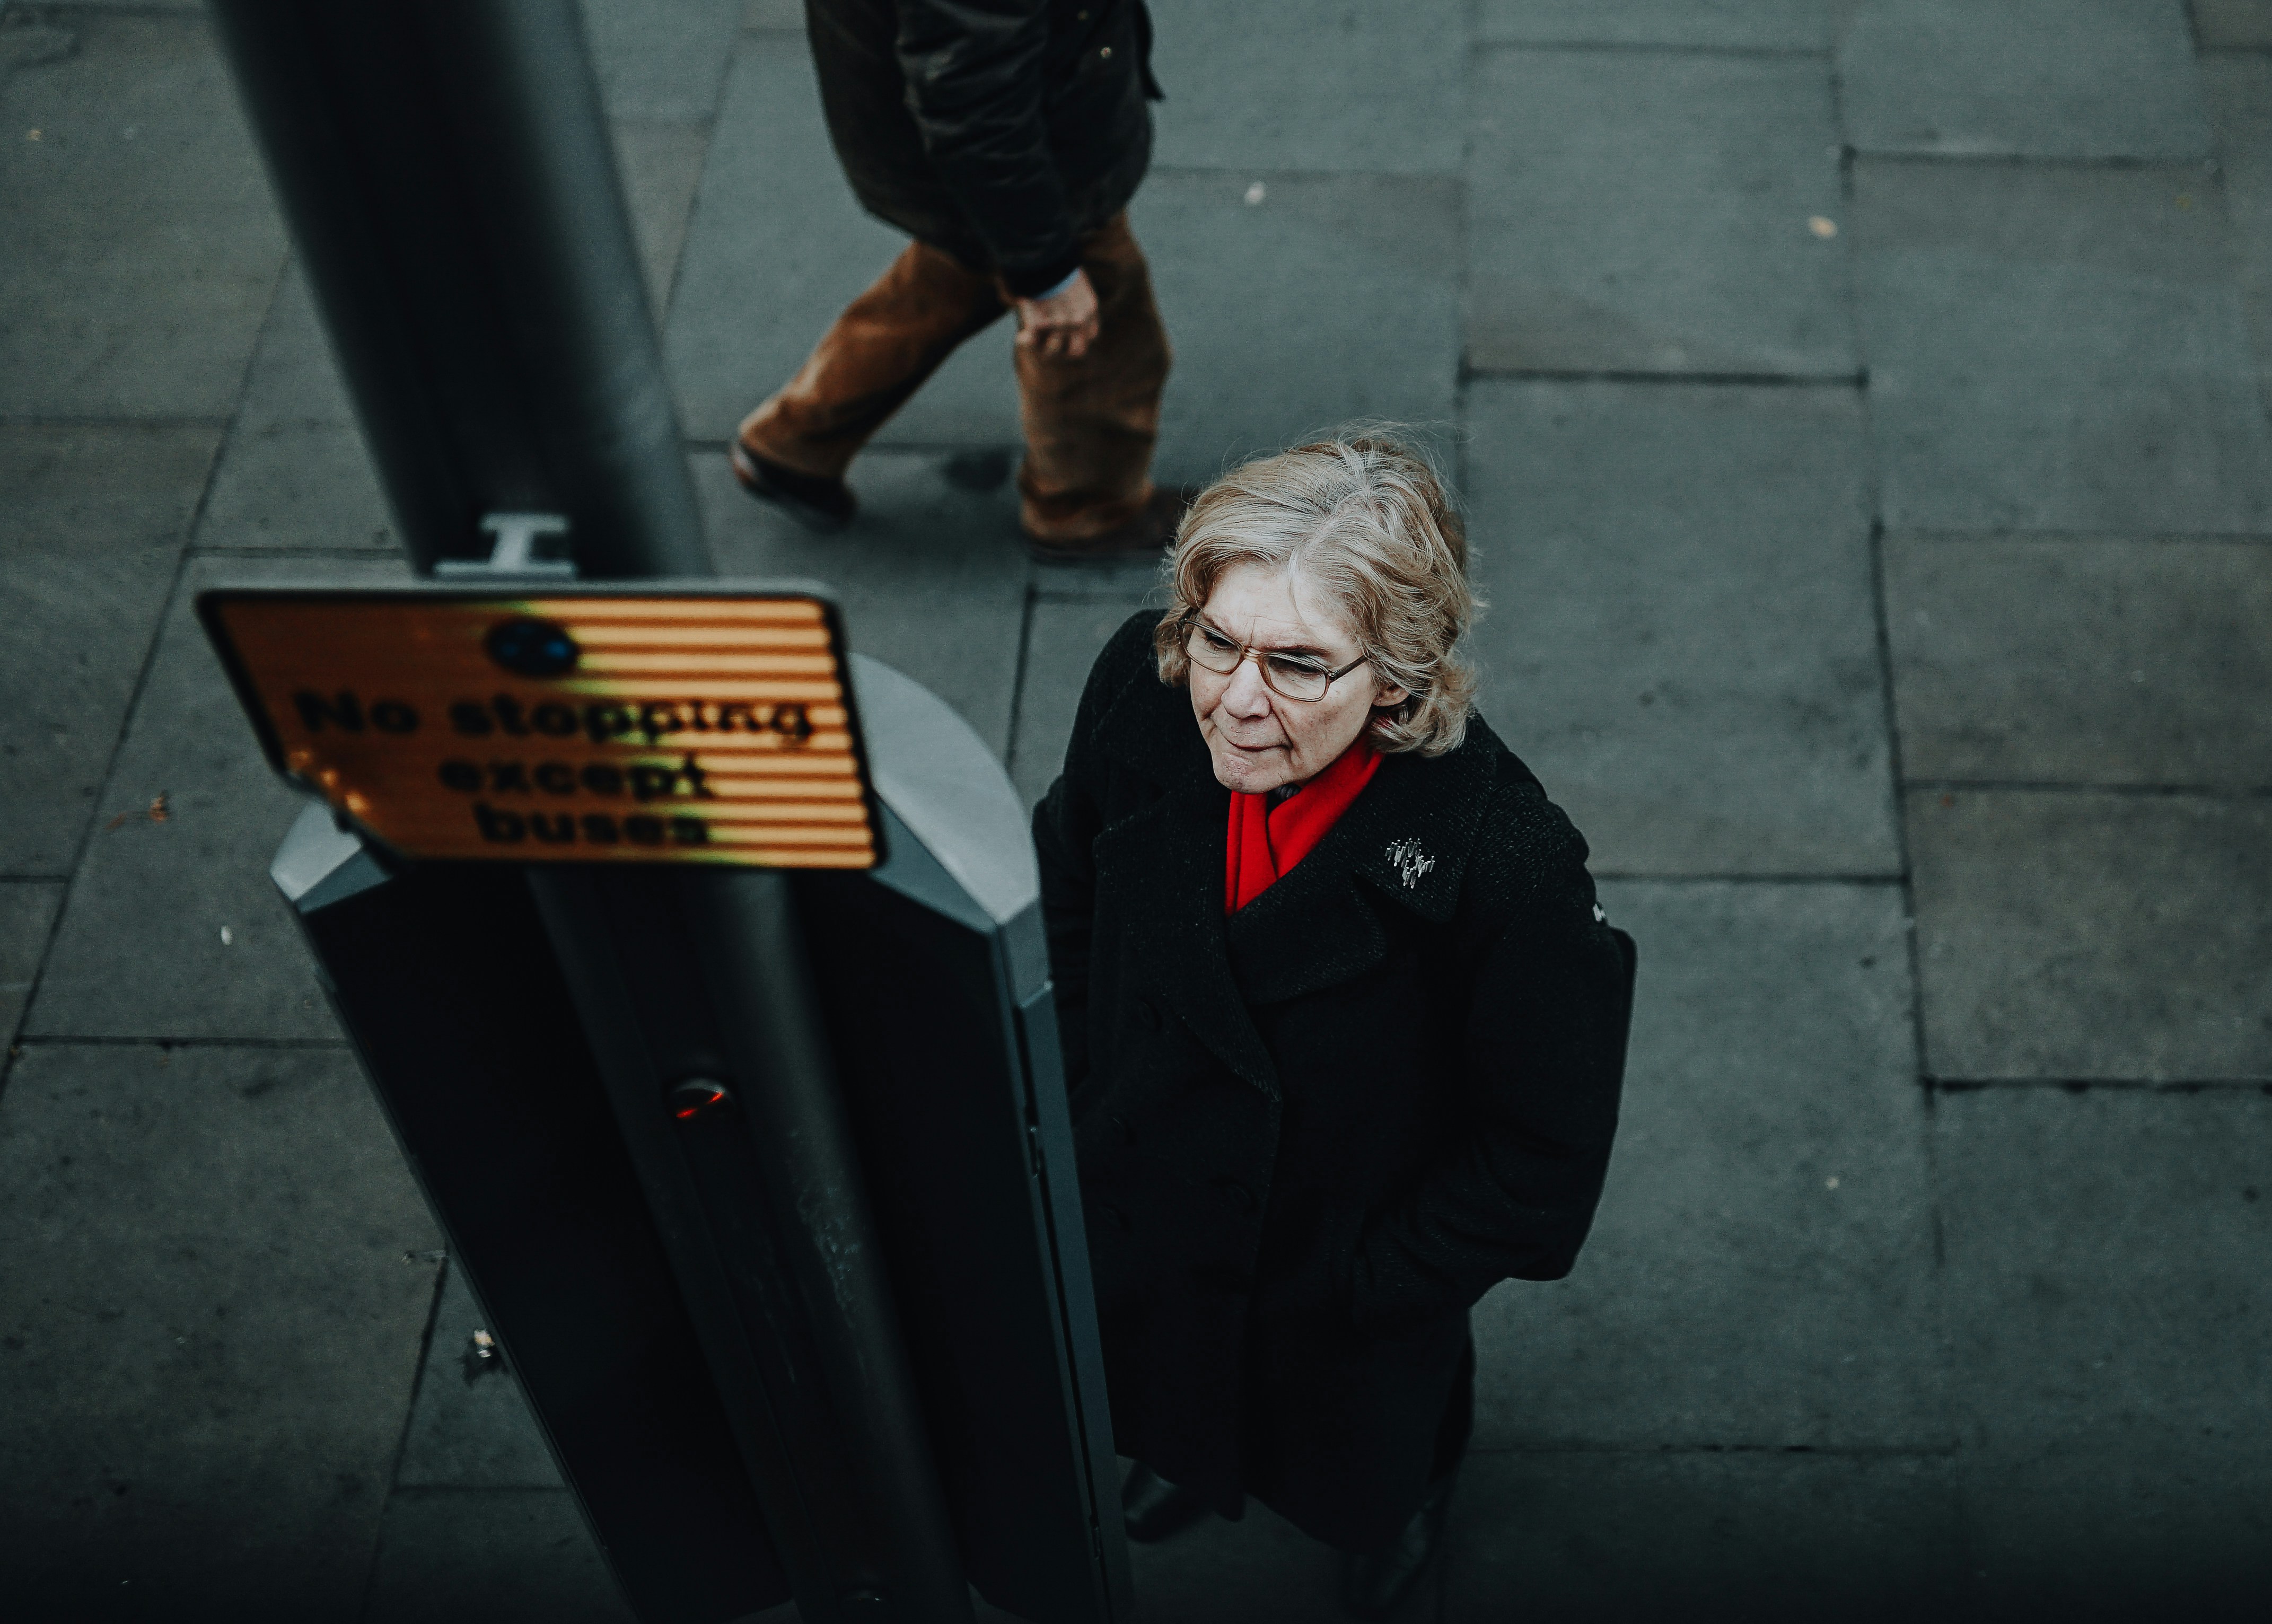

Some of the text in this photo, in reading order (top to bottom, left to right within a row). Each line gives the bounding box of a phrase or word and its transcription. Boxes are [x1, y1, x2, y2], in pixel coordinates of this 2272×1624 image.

[293, 691, 812, 749] No stopping
[438, 751, 715, 802] except
[473, 802, 708, 844] buses
